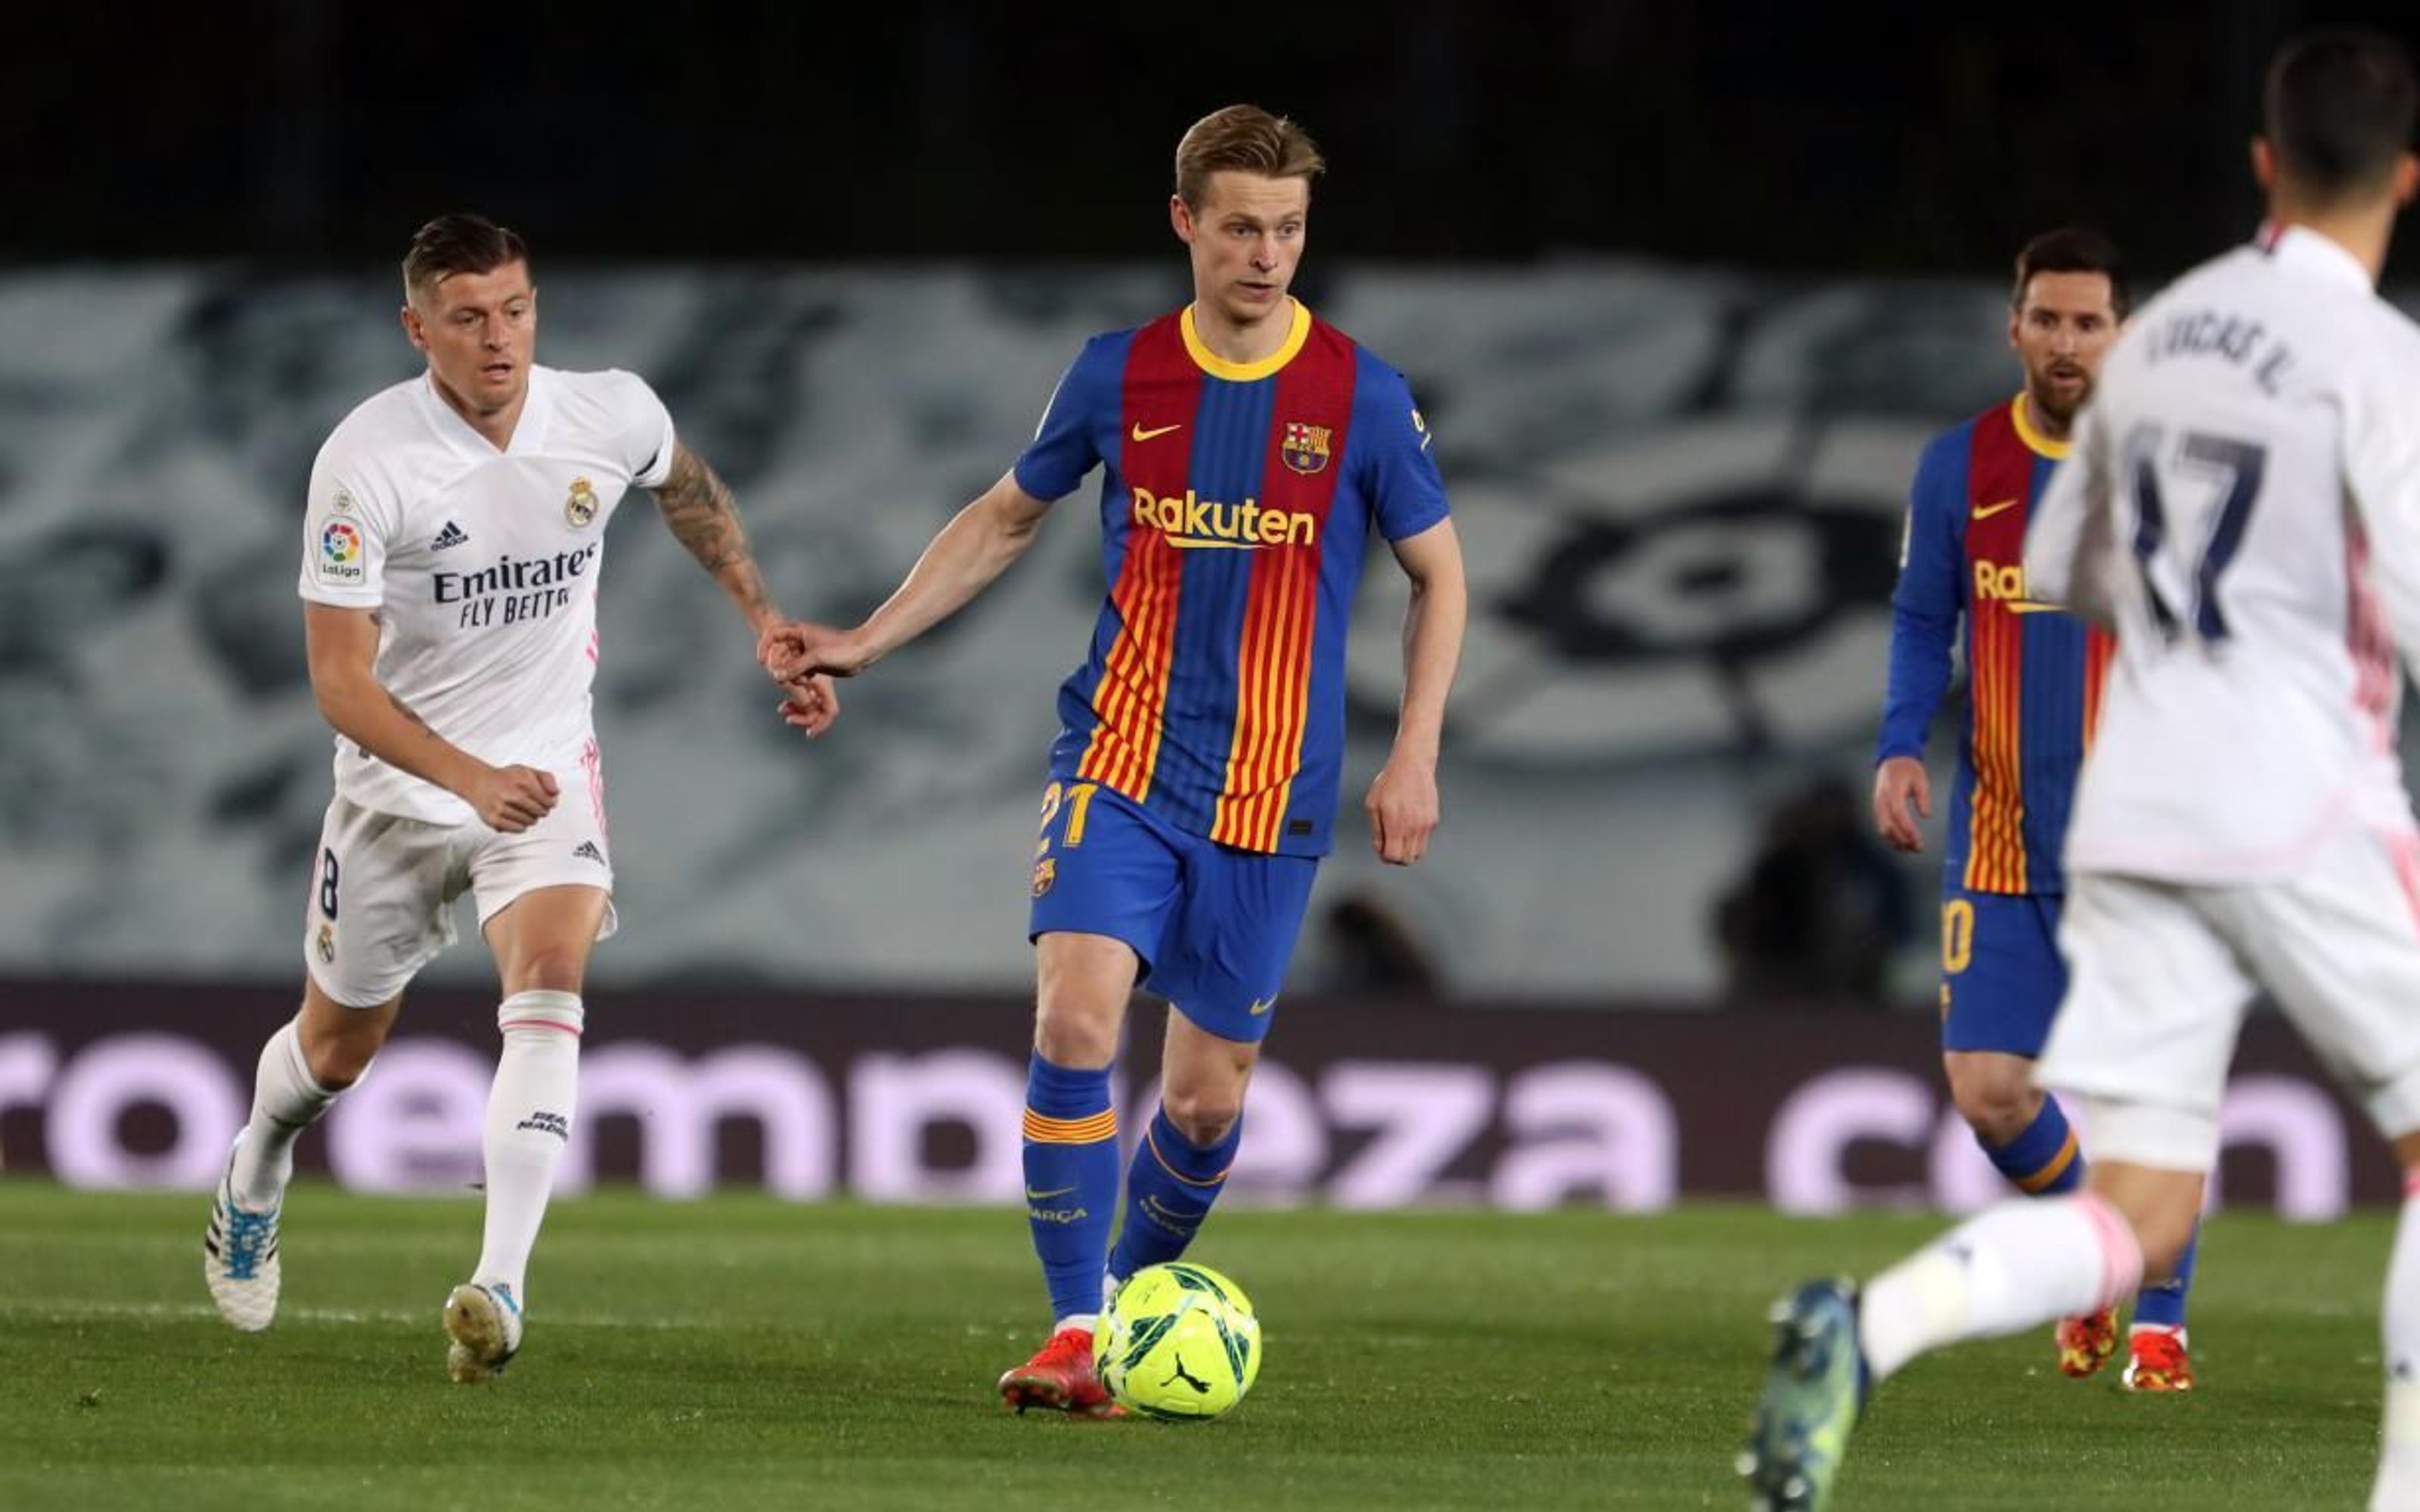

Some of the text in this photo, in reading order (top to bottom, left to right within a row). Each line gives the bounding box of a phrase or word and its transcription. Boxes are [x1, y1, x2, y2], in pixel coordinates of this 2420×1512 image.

[1134, 487, 1314, 546] Rakuten
[2127, 420, 2267, 652] 17
[323, 563, 360, 577] LaLiga
[460, 596, 495, 628] FLY
[1038, 781, 1100, 855] 21
[321, 847, 338, 922] 8
[327, 1036, 1677, 1213] empeza
